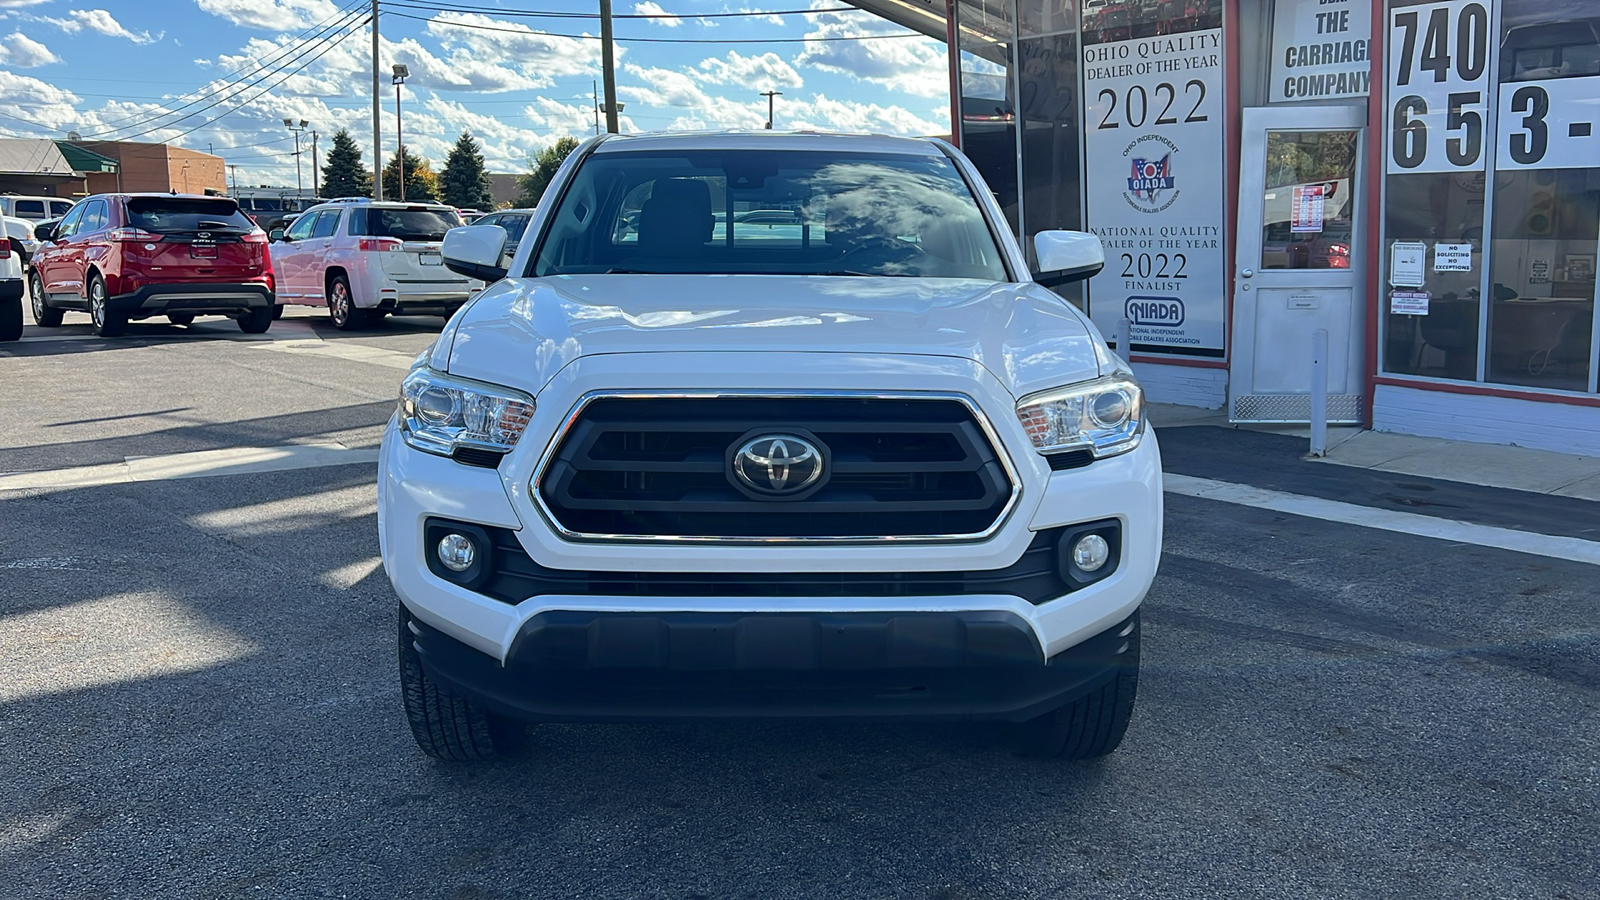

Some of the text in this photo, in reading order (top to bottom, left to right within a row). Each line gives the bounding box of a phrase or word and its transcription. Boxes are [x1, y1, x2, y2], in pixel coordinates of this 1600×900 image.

[1316, 10, 1349, 34] THE
[1085, 33, 1221, 63] OHIO QUALITY
[1394, 3, 1488, 86] 740
[1087, 54, 1218, 80] DEALER OF THE YEAR
[1284, 70, 1371, 98] COMPANY
[1097, 79, 1209, 130] 2022
[1122, 134, 1180, 157] OHIO INDEPENDENT
[1133, 178, 1167, 190] OIADA
[1122, 192, 1143, 212] AUTOMOBILE
[1160, 189, 1181, 212] ASSOCIATION
[1090, 226, 1220, 238] NATIONAL QUALITY
[1100, 239, 1218, 249] EALER OF THE YEAR
[1120, 252, 1188, 279] 2022
[1125, 281, 1182, 291] FINALIST
[1129, 302, 1179, 321] NIADA
[1129, 326, 1185, 336] ATIONAL INDEPENDENT
